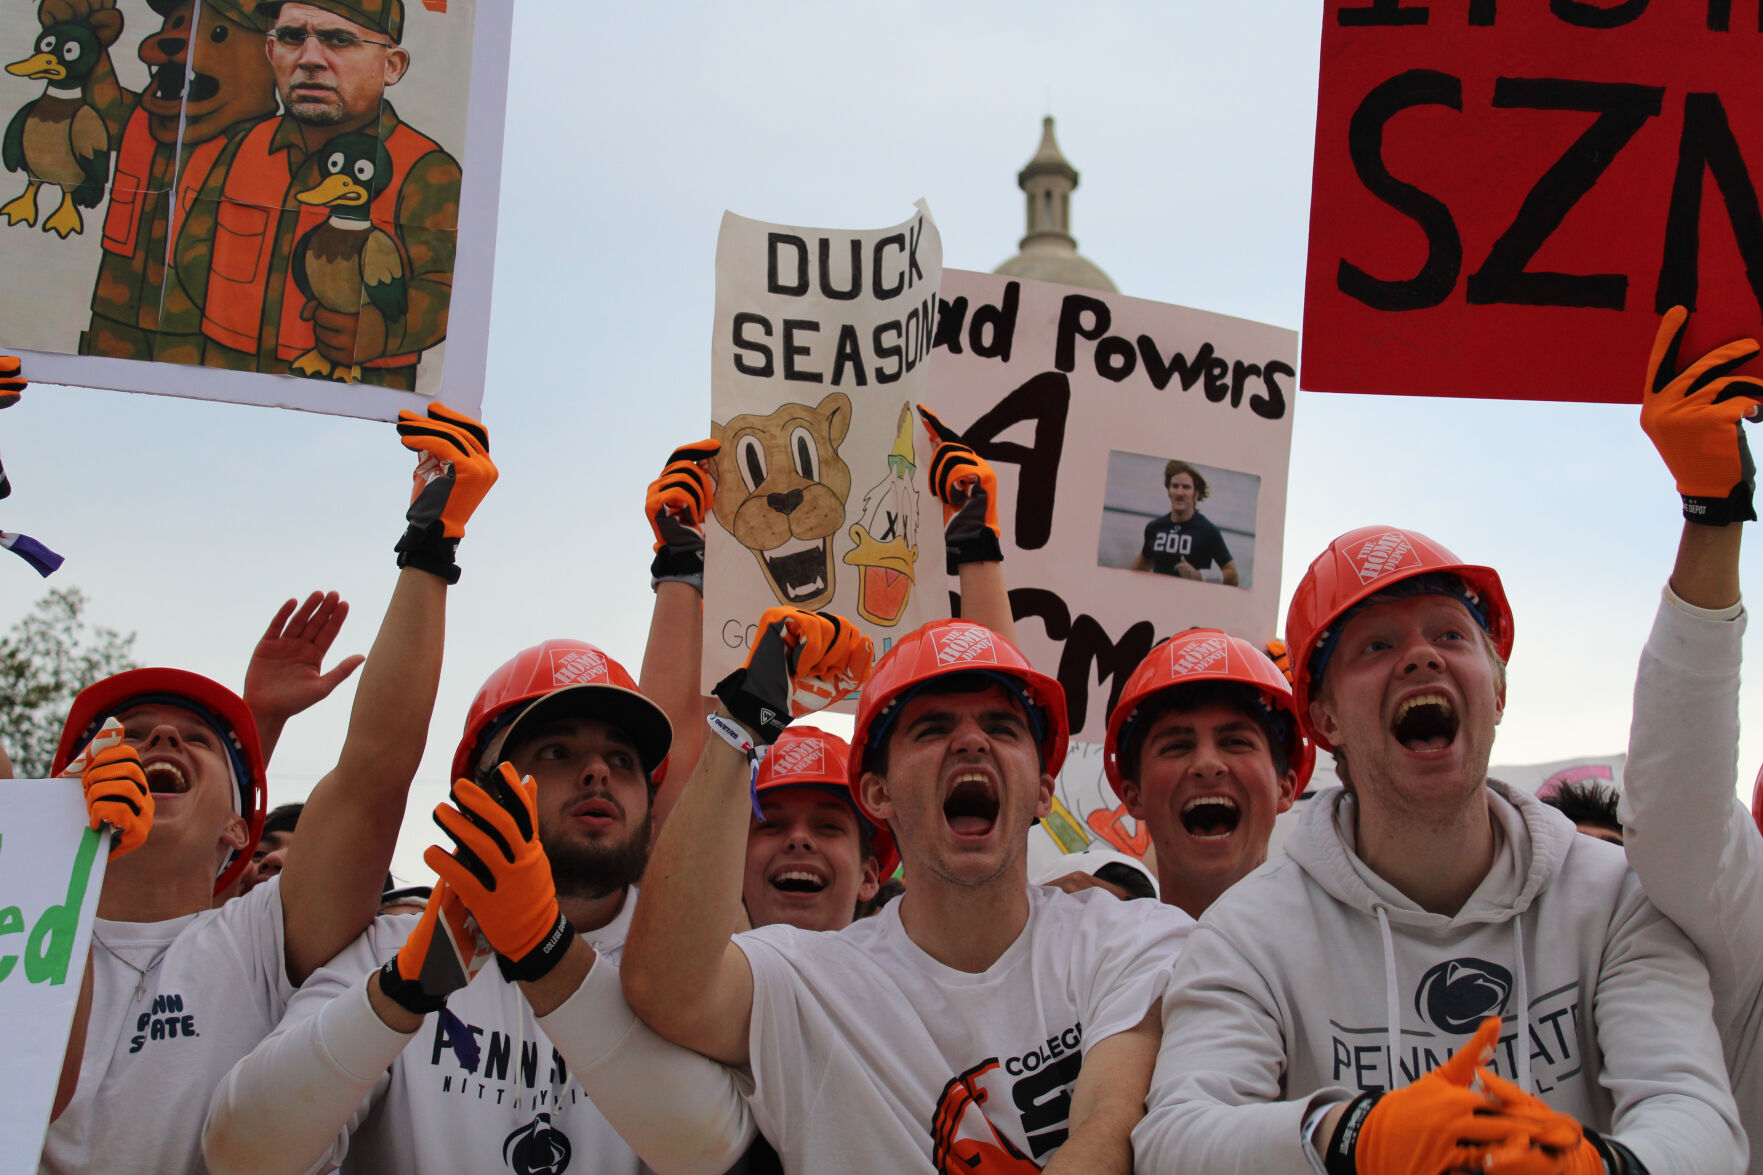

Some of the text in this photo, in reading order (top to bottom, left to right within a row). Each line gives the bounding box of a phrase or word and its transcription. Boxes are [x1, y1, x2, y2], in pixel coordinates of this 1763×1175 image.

[767, 215, 923, 301] DUCK
[732, 291, 938, 387] SEASON
[1055, 294, 1296, 420] Powers
[1153, 532, 1192, 555] 200
[1356, 542, 1377, 560] THE
[1360, 532, 1404, 578] HOME
[1384, 542, 1412, 571] DEPOT
[939, 628, 990, 663] HOME
[940, 630, 962, 643] THE
[1177, 641, 1200, 655] THE
[559, 652, 579, 665] THE
[961, 639, 993, 661] DEPOT
[1173, 639, 1226, 675] HOME
[1194, 649, 1226, 672] DEPOT
[555, 652, 605, 684] HOME
[577, 663, 607, 684] DEPOT
[775, 738, 824, 774] HOME
[777, 741, 800, 755] THE
[793, 749, 824, 772] DEPOT
